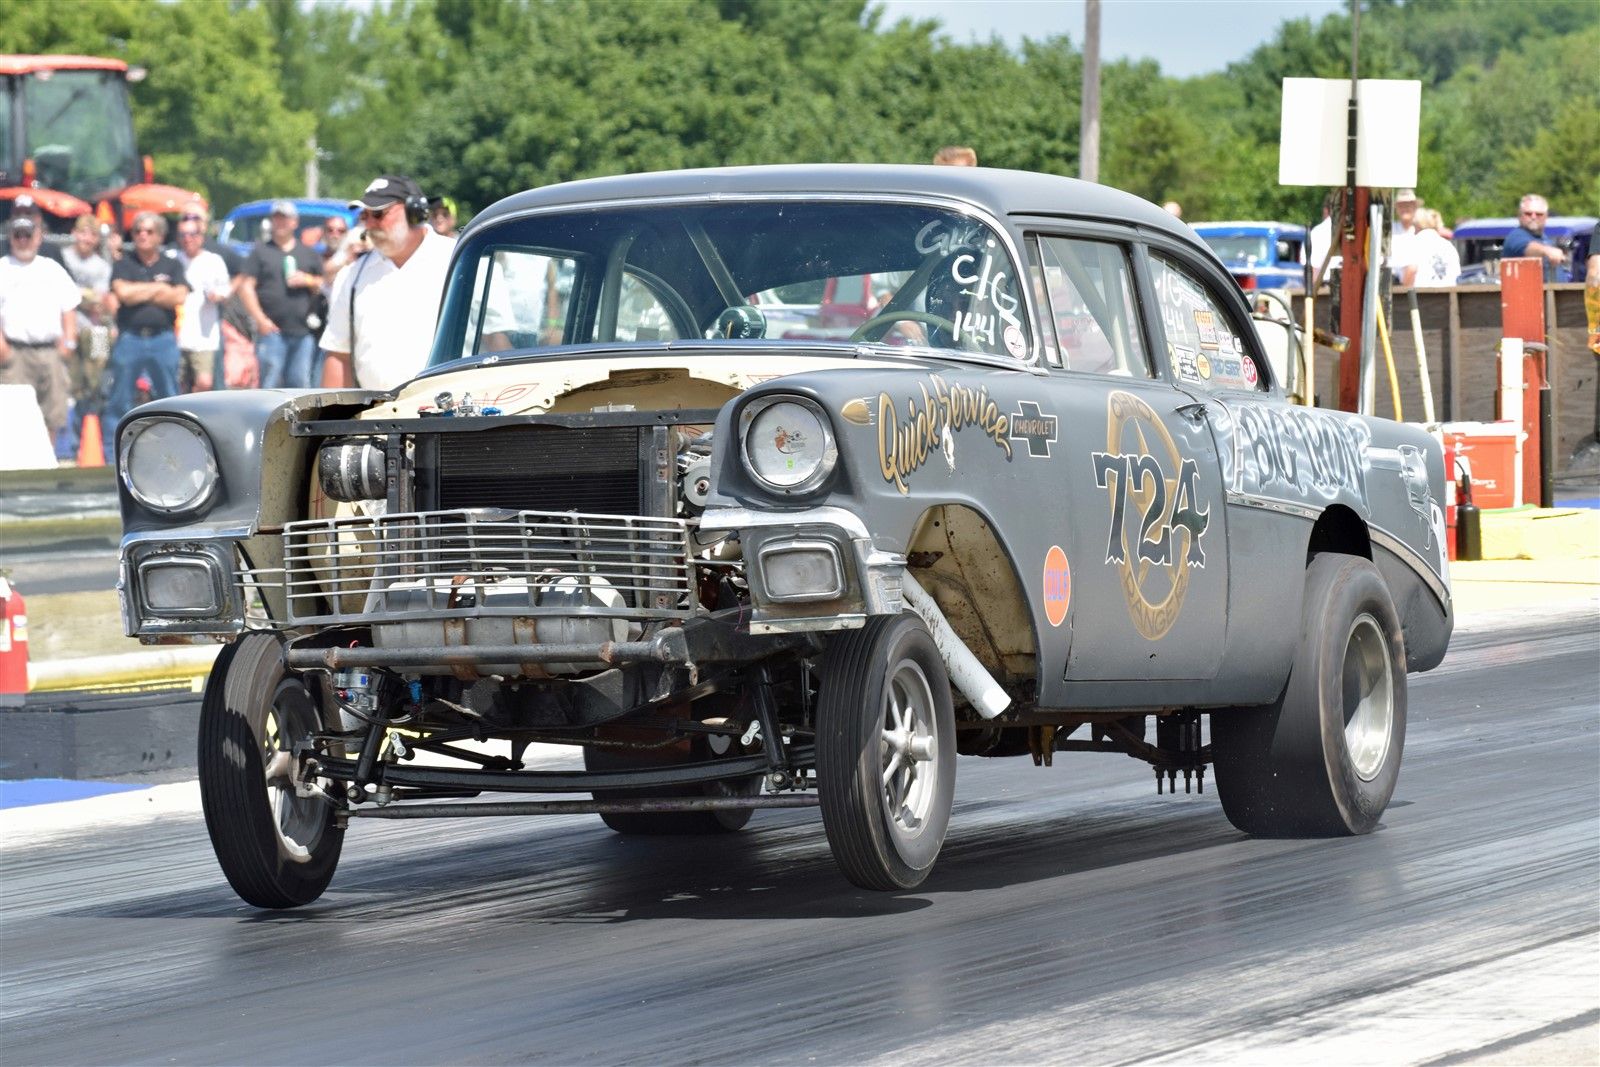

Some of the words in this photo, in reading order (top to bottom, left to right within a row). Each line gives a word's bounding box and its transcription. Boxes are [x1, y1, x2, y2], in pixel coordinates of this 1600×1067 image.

[952, 311, 995, 346] 144
[1243, 358, 1256, 382] STP
[878, 381, 940, 495] Quick
[929, 373, 1013, 462] Service
[1014, 420, 1054, 436] CHEVROLET
[1239, 404, 1303, 494] BIG
[1286, 408, 1371, 516] IRON
[1091, 452, 1210, 568] 724
[1125, 571, 1185, 636] RANGER
